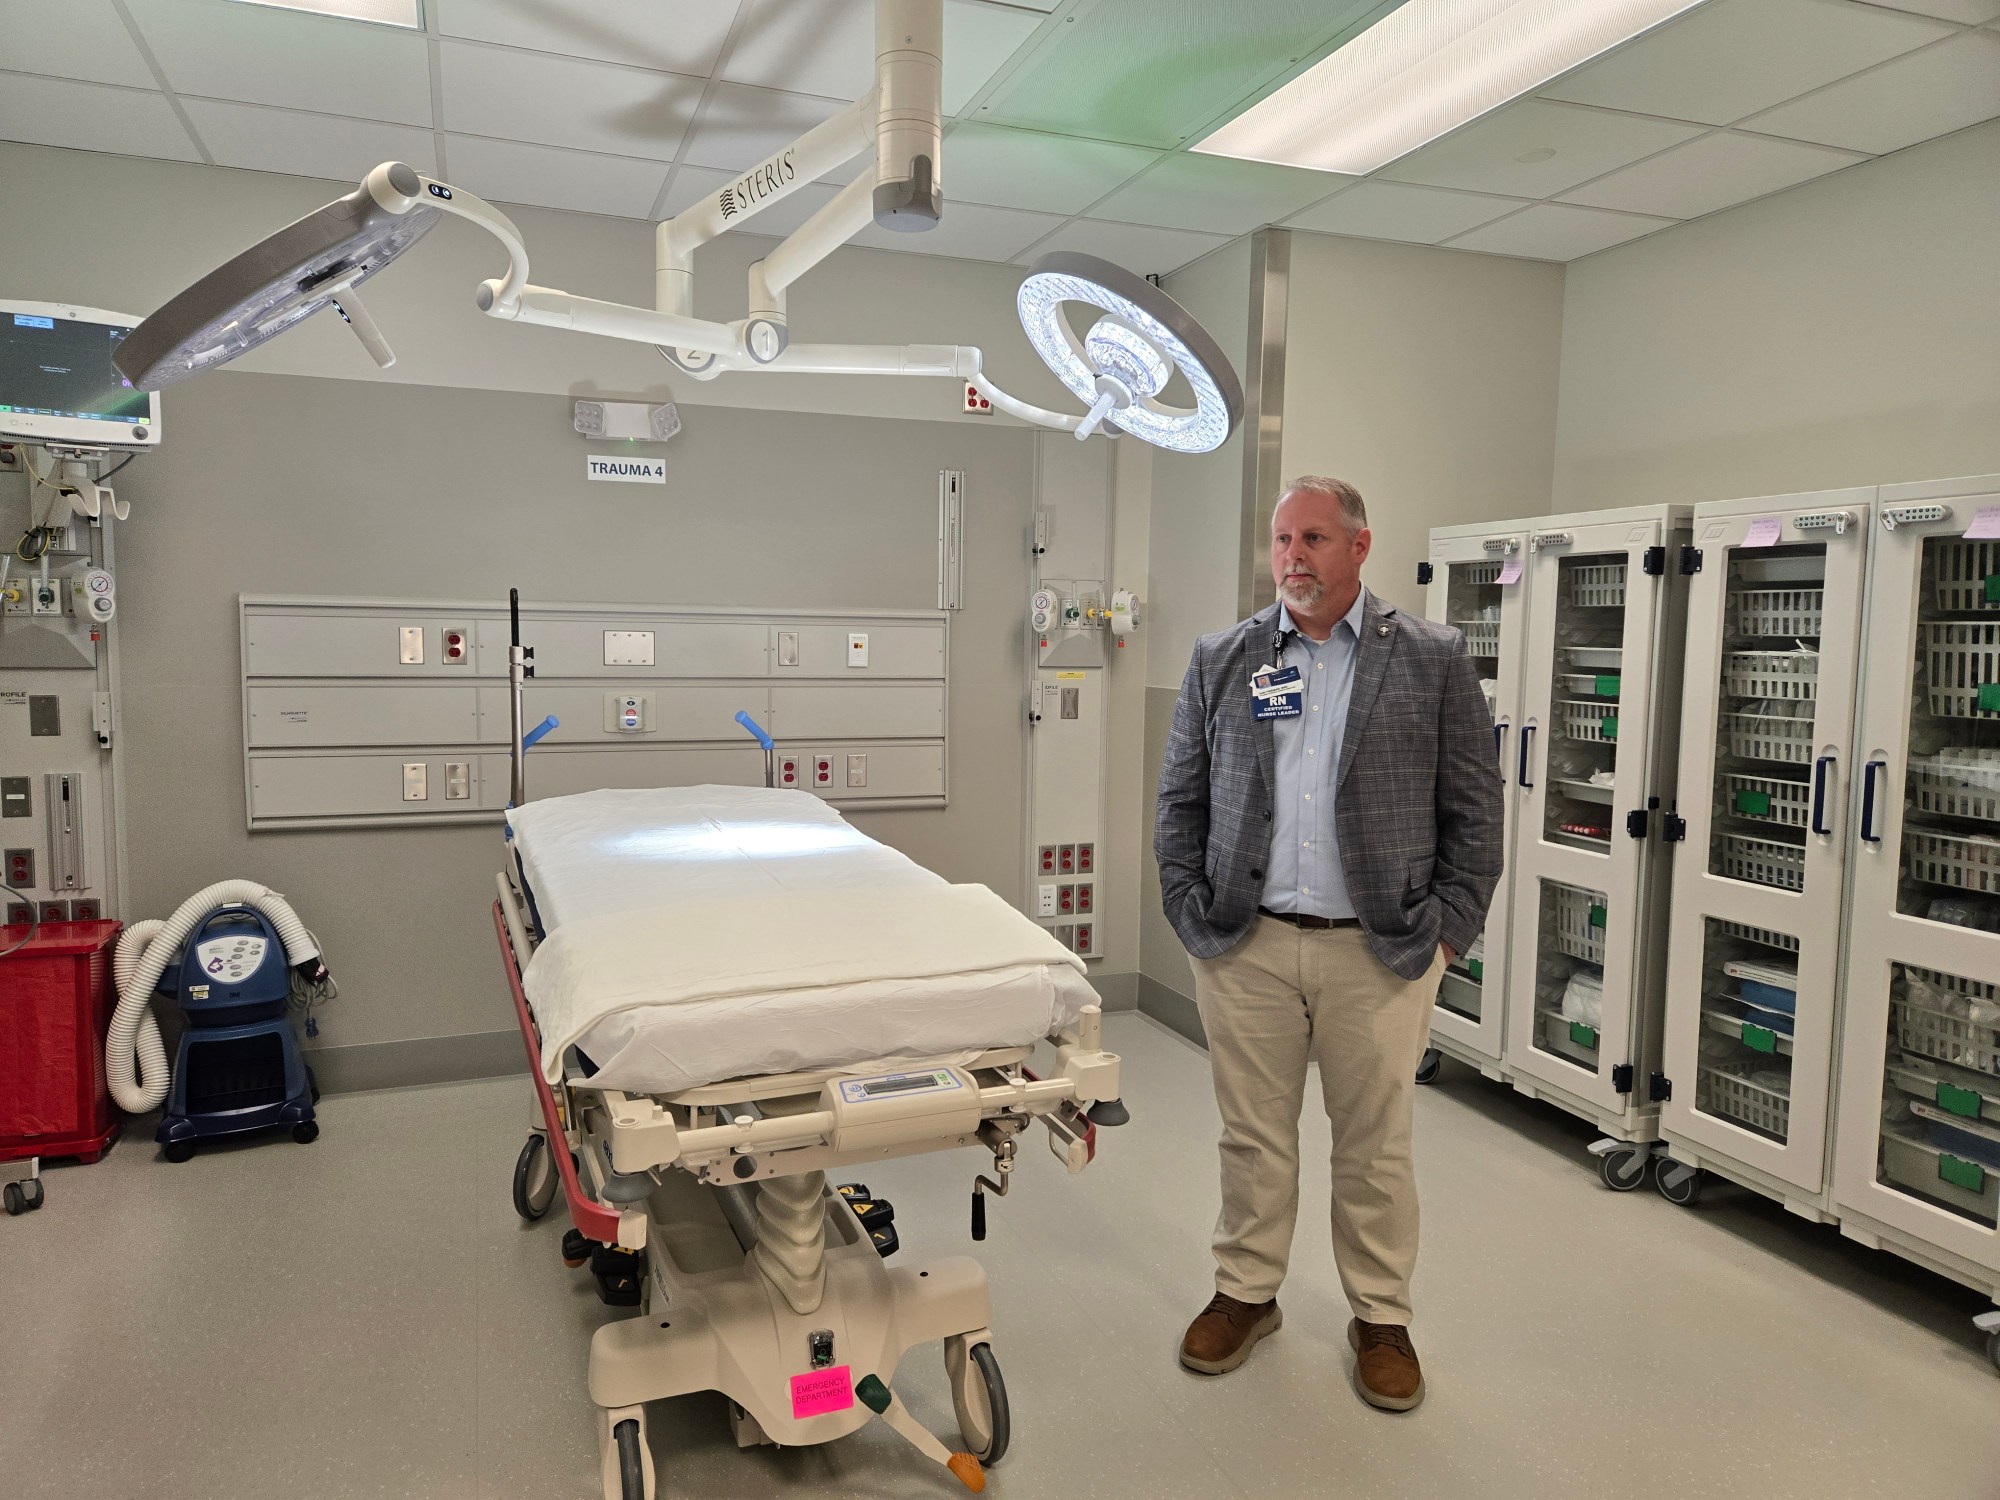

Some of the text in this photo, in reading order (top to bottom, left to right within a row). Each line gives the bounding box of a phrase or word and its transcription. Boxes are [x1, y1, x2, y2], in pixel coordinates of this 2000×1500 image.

[736, 151, 795, 209] STERIS
[590, 462, 663, 477] TRAUMA 4
[1269, 695, 1287, 706] RN
[796, 1376, 845, 1395] EMERGENCY
[795, 1386, 848, 1405] DEPARTMENT
